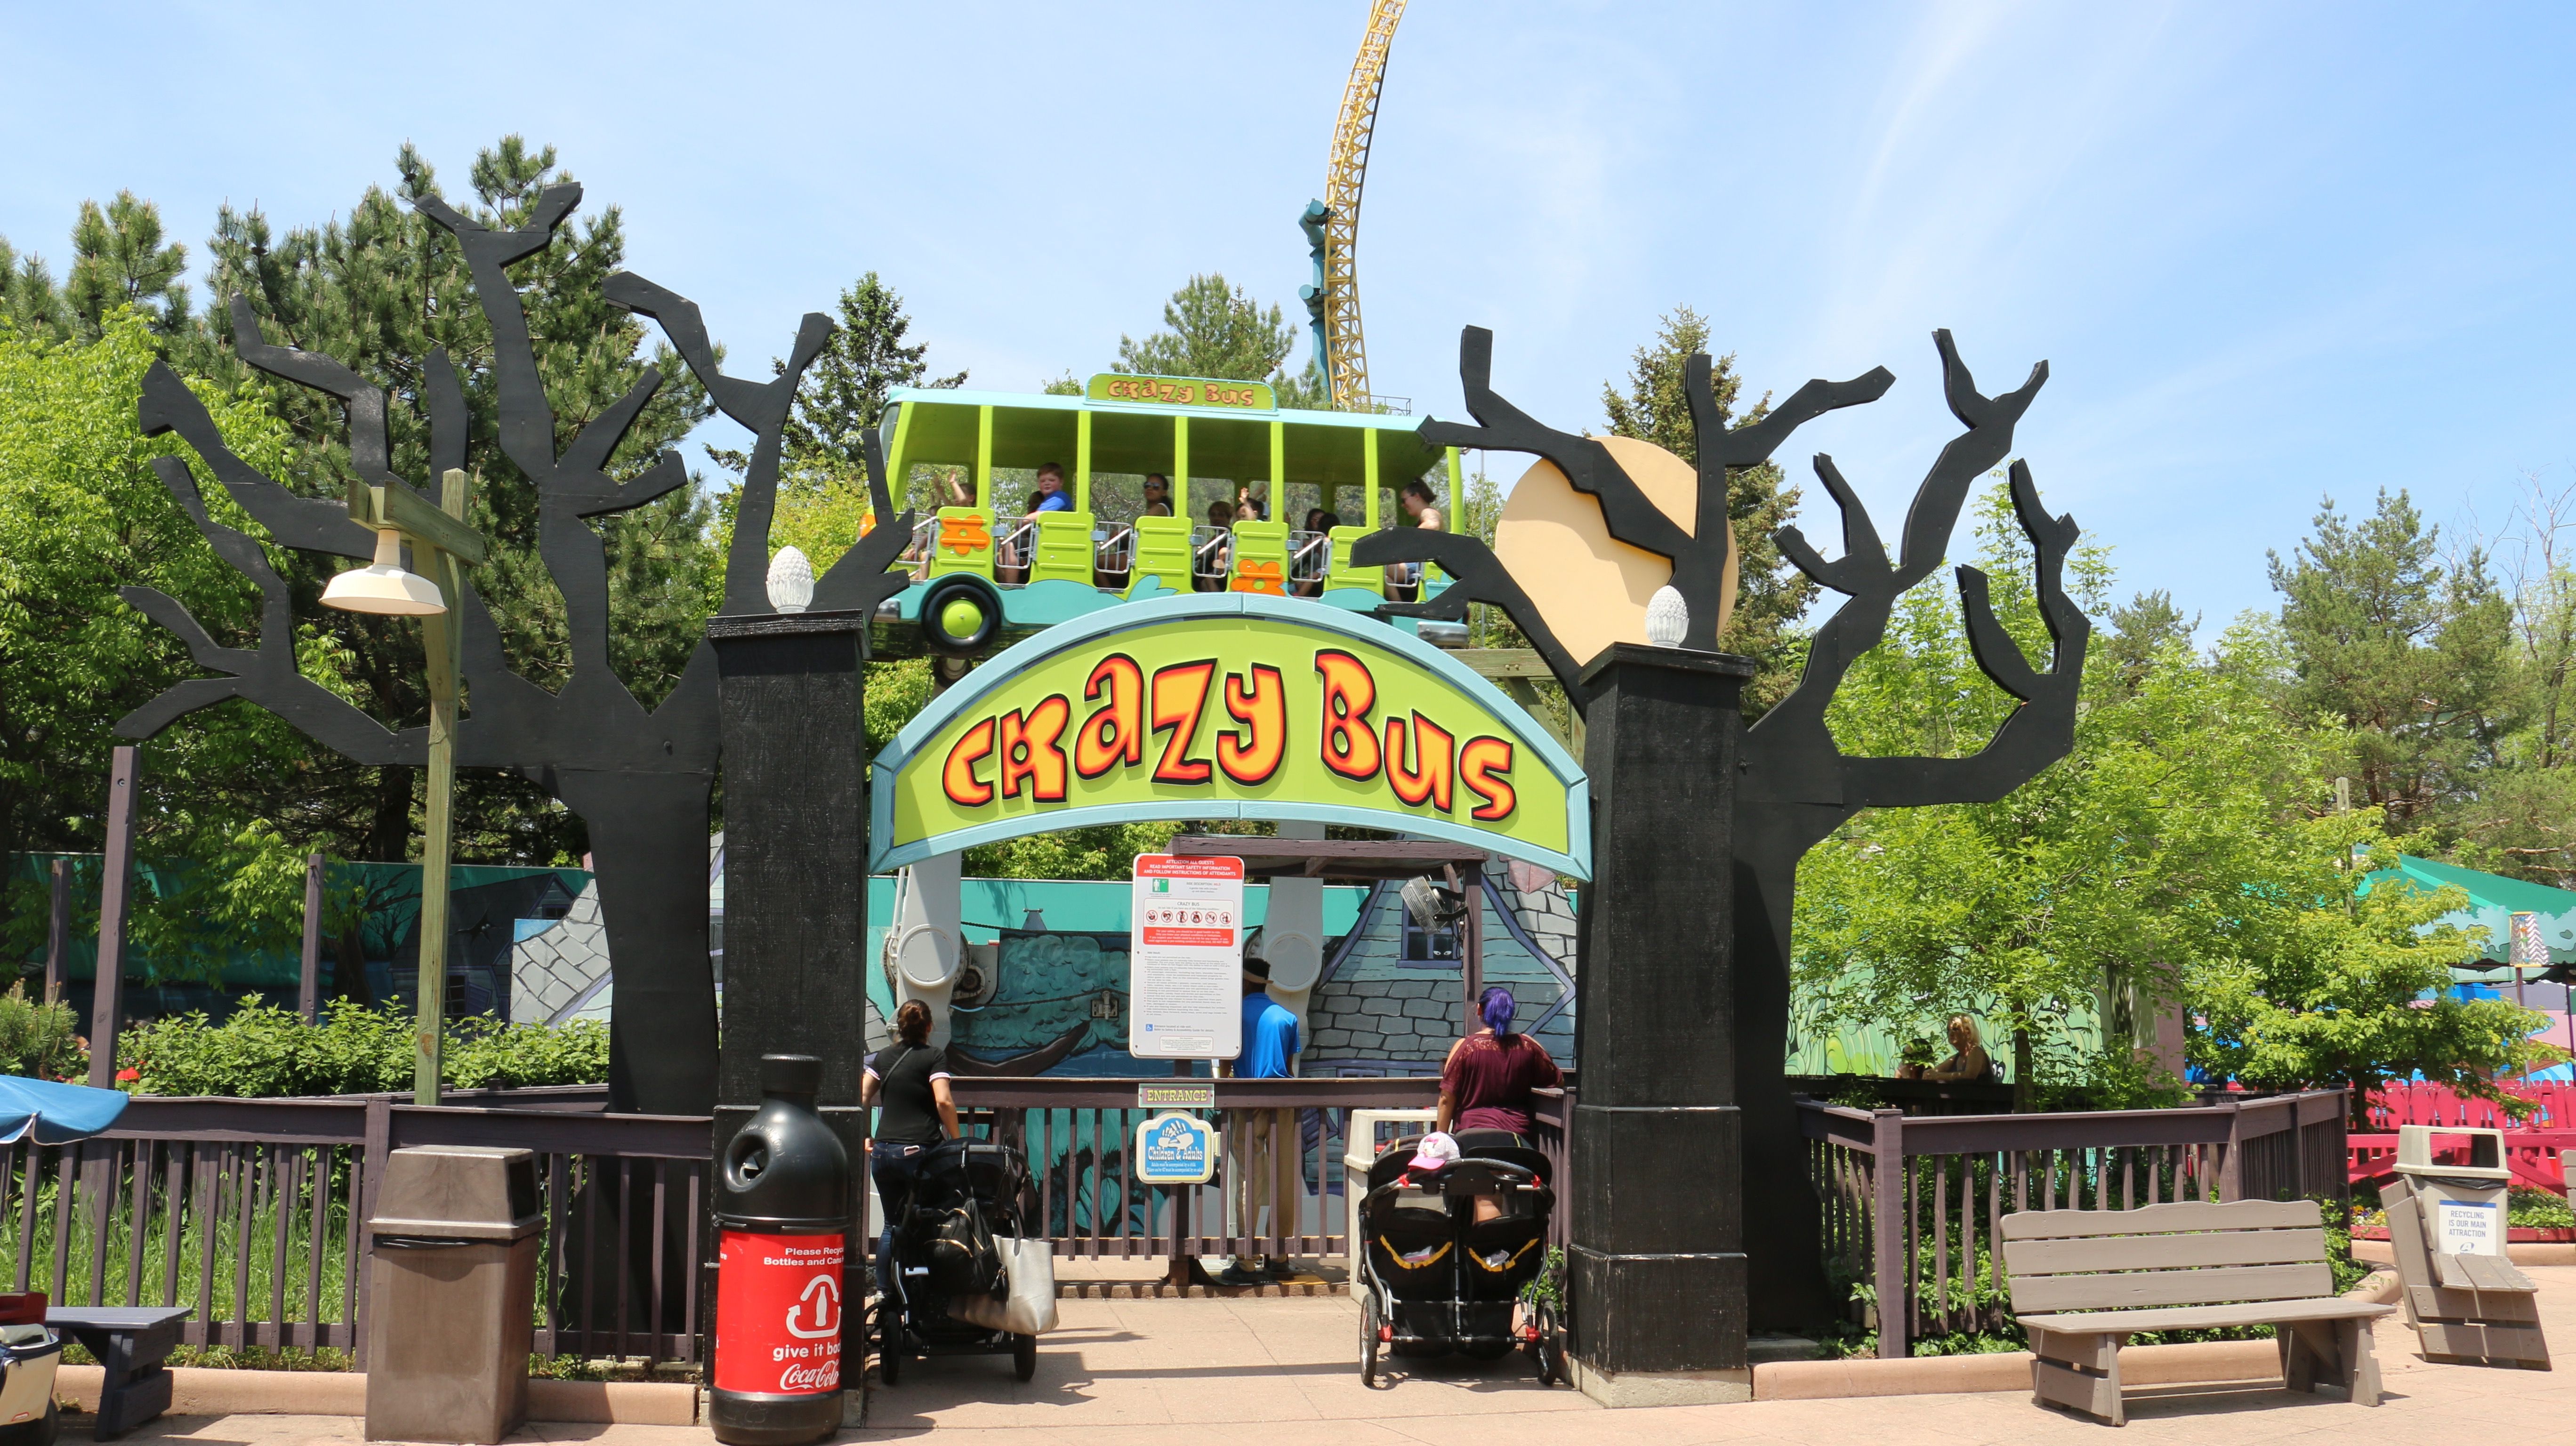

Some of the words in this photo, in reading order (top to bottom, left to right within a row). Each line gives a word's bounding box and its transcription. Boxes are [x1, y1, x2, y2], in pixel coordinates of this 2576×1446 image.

[1147, 1090, 1207, 1102] ENTRANCE
[1148, 1146, 1174, 1161] Children
[1176, 1149, 1181, 1161] &
[1183, 1147, 1202, 1160] Adults
[2451, 1210, 2484, 1219] RECYCLING
[2449, 1229, 2486, 1237] ATTRACTION
[764, 1257, 804, 1266] Bottles
[807, 1258, 825, 1266] and
[773, 1344, 809, 1361] give
[814, 1343, 824, 1357] it
[780, 1359, 839, 1390] Coca-Cola
